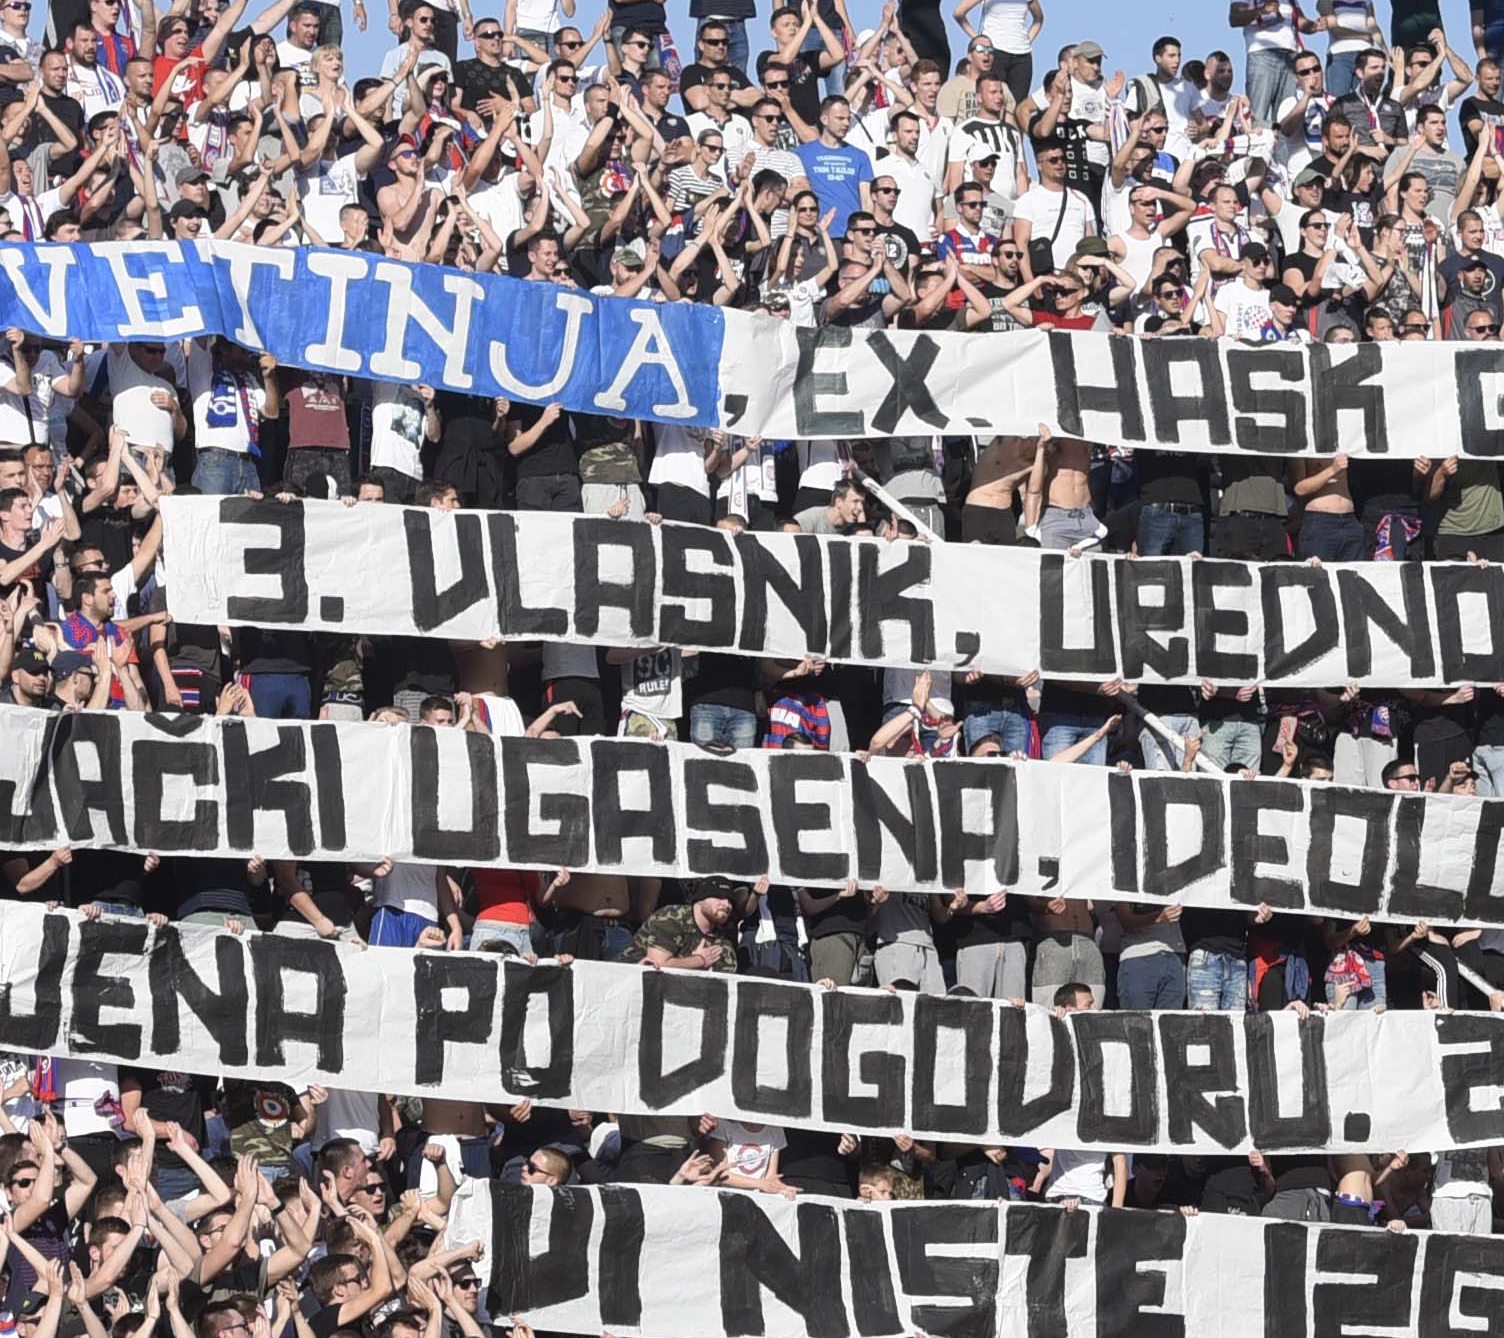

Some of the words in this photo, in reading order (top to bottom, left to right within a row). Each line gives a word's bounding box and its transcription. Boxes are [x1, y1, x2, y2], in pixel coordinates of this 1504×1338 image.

[1050, 329, 1388, 455] HASK
[219, 495, 344, 624] 3.
[407, 509, 983, 668] VLASNIK,
[414, 953, 575, 1098] PO
[638, 967, 1373, 1151] DOGOVORU.
[489, 1181, 643, 1327] VI
